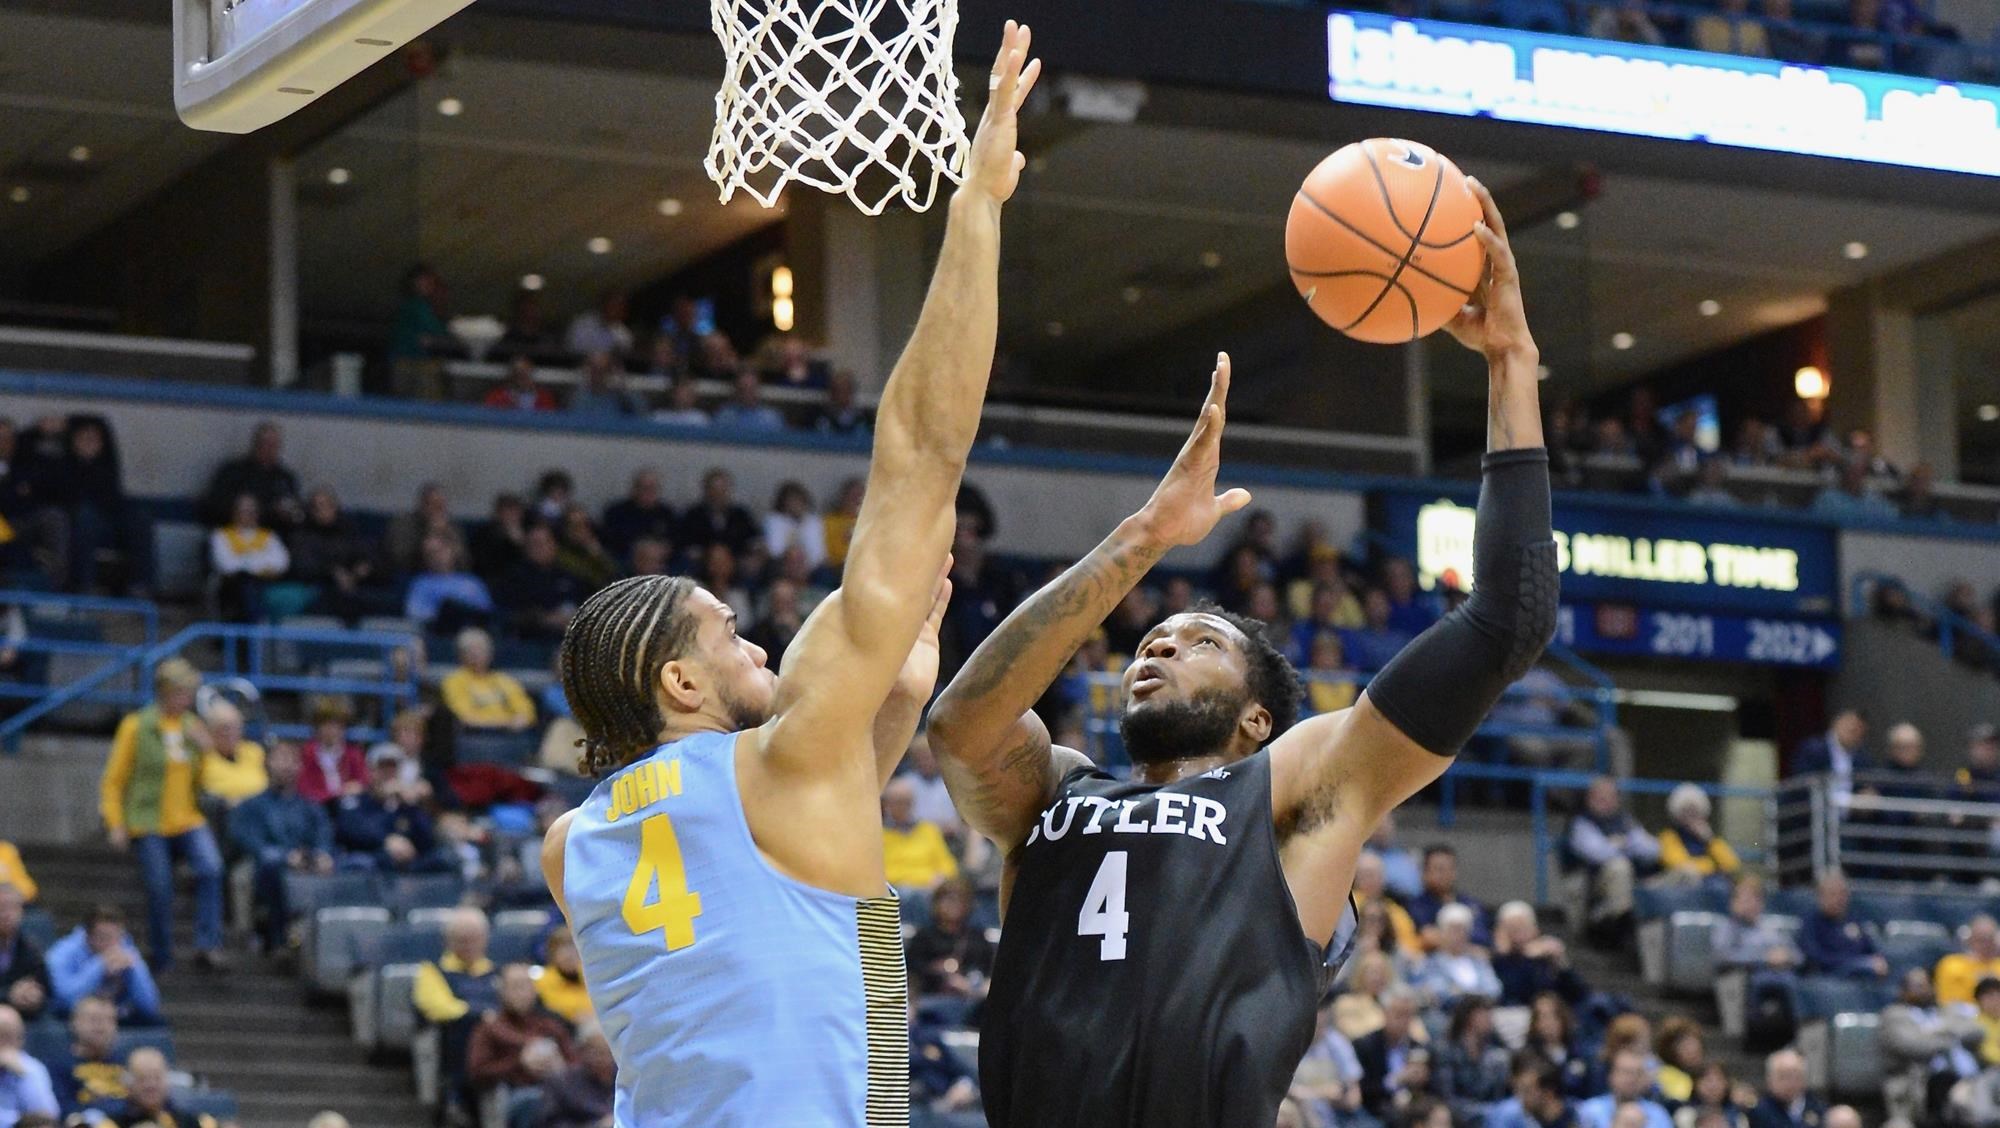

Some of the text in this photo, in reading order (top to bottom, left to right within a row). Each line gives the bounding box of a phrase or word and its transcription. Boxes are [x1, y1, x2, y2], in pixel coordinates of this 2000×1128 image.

[1571, 532, 1708, 585] MILLER
[1707, 543, 1798, 592] TIME
[1653, 611, 1811, 664] 201 202
[606, 759, 682, 822] JOHN
[621, 812, 702, 952] 4
[1077, 850, 1129, 961] 4
